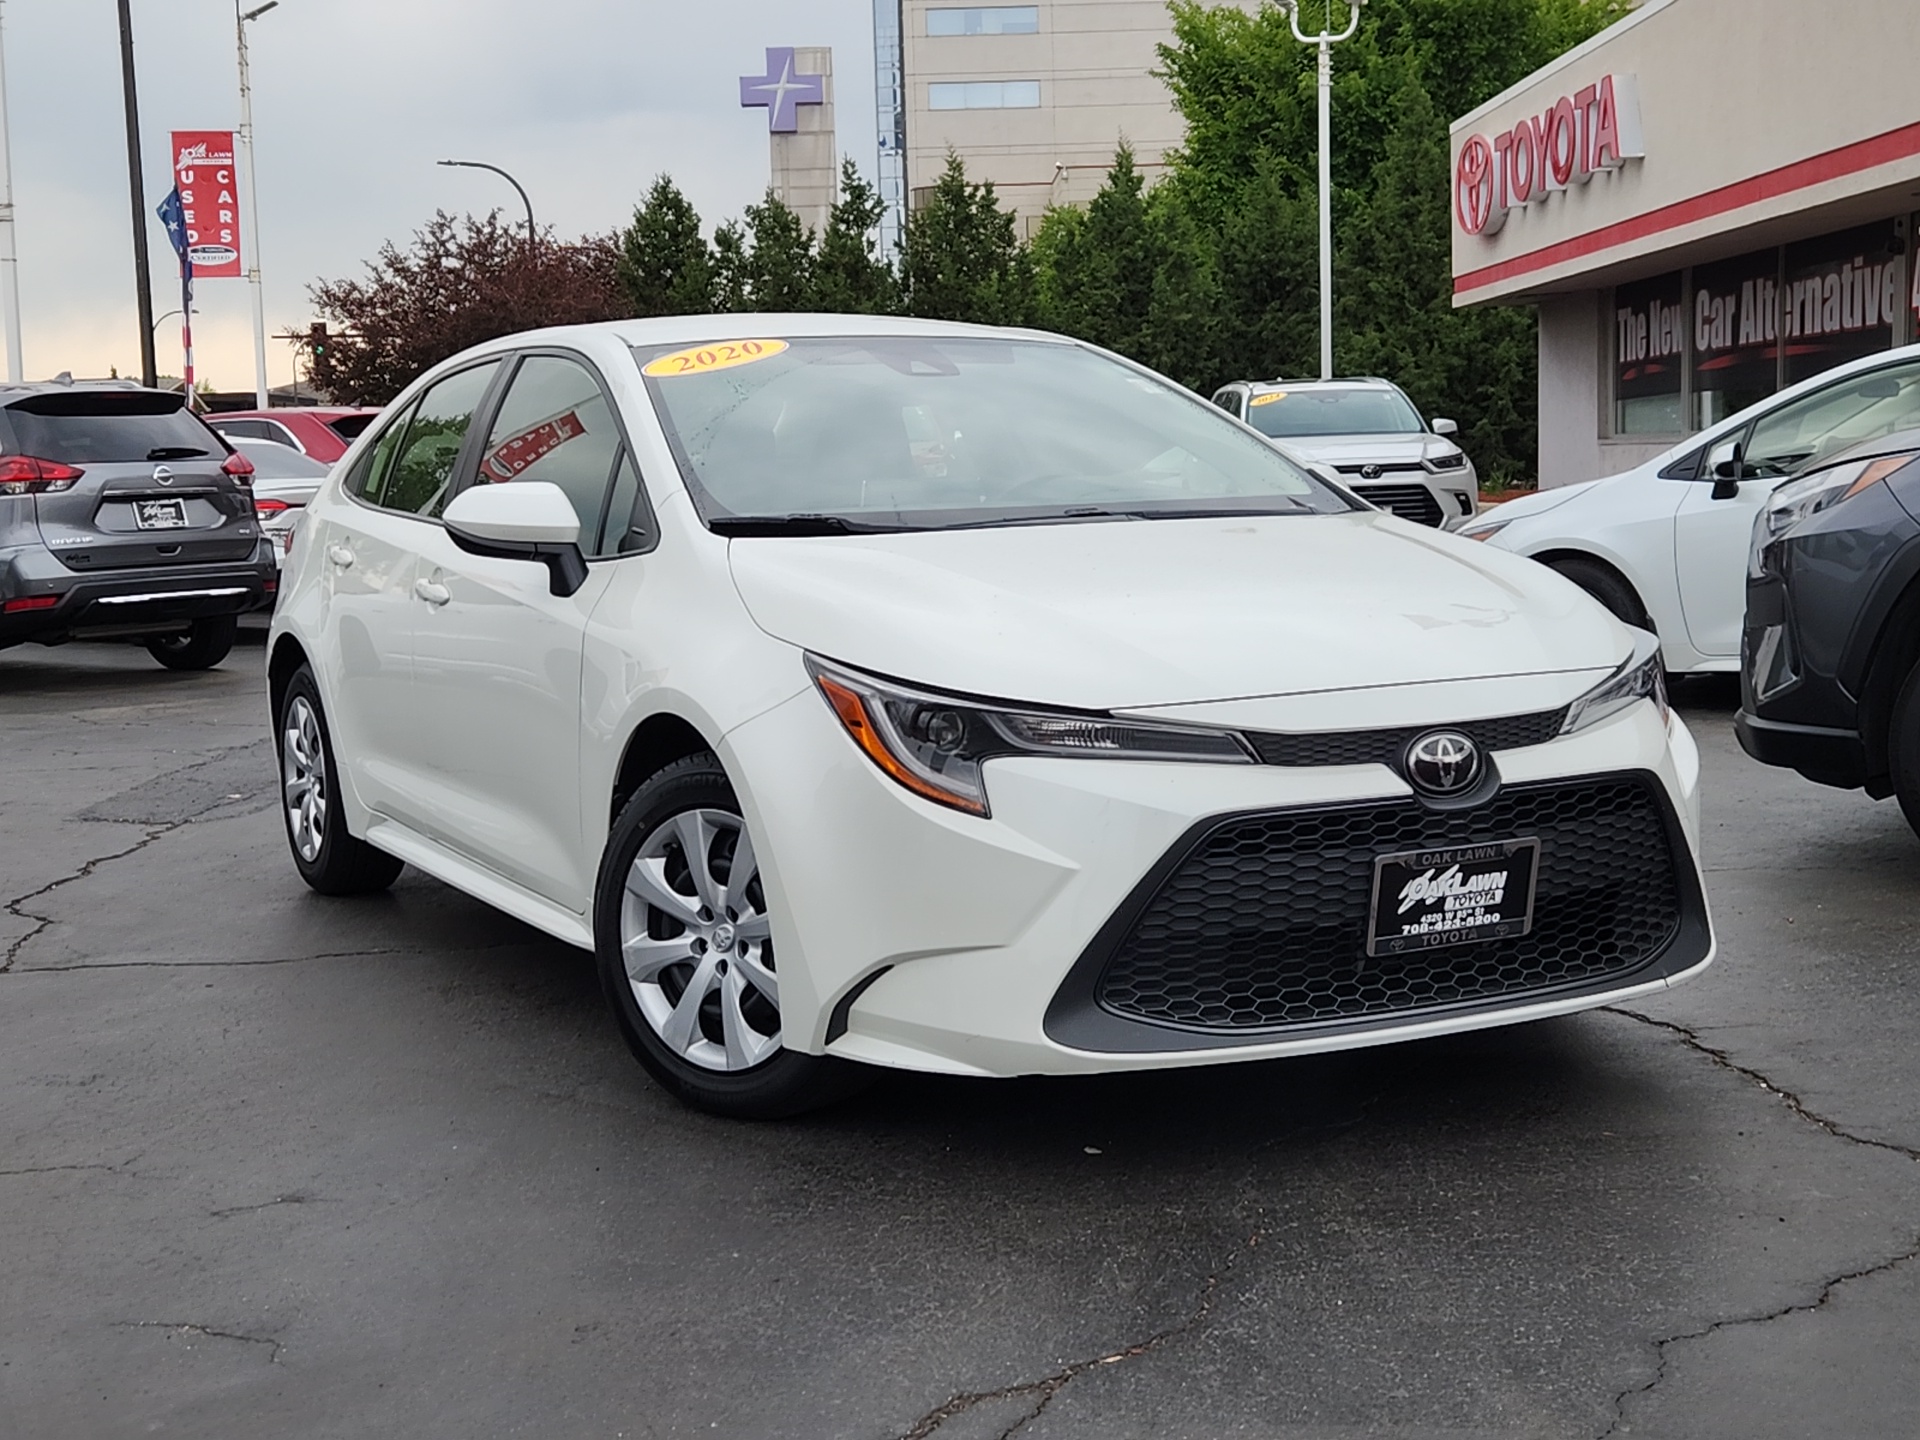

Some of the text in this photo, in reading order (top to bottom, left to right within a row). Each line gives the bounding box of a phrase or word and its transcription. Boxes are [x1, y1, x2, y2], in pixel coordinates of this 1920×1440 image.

[1494, 74, 1620, 210] TOYOTA
[180, 169, 199, 243] USED
[216, 169, 233, 243] CARS
[1617, 306, 1647, 363] The
[1695, 289, 1736, 351] Car
[1738, 256, 1895, 345] Alternative
[671, 341, 763, 373] 2020
[1421, 846, 1497, 866] OAK LAWN
[1445, 911, 1455, 921] W
[1474, 906, 1485, 917] St
[1452, 890, 1497, 909] TOYOTA
[1401, 912, 1501, 936] 708-423-5200
[1421, 928, 1479, 947] TOYOTA
